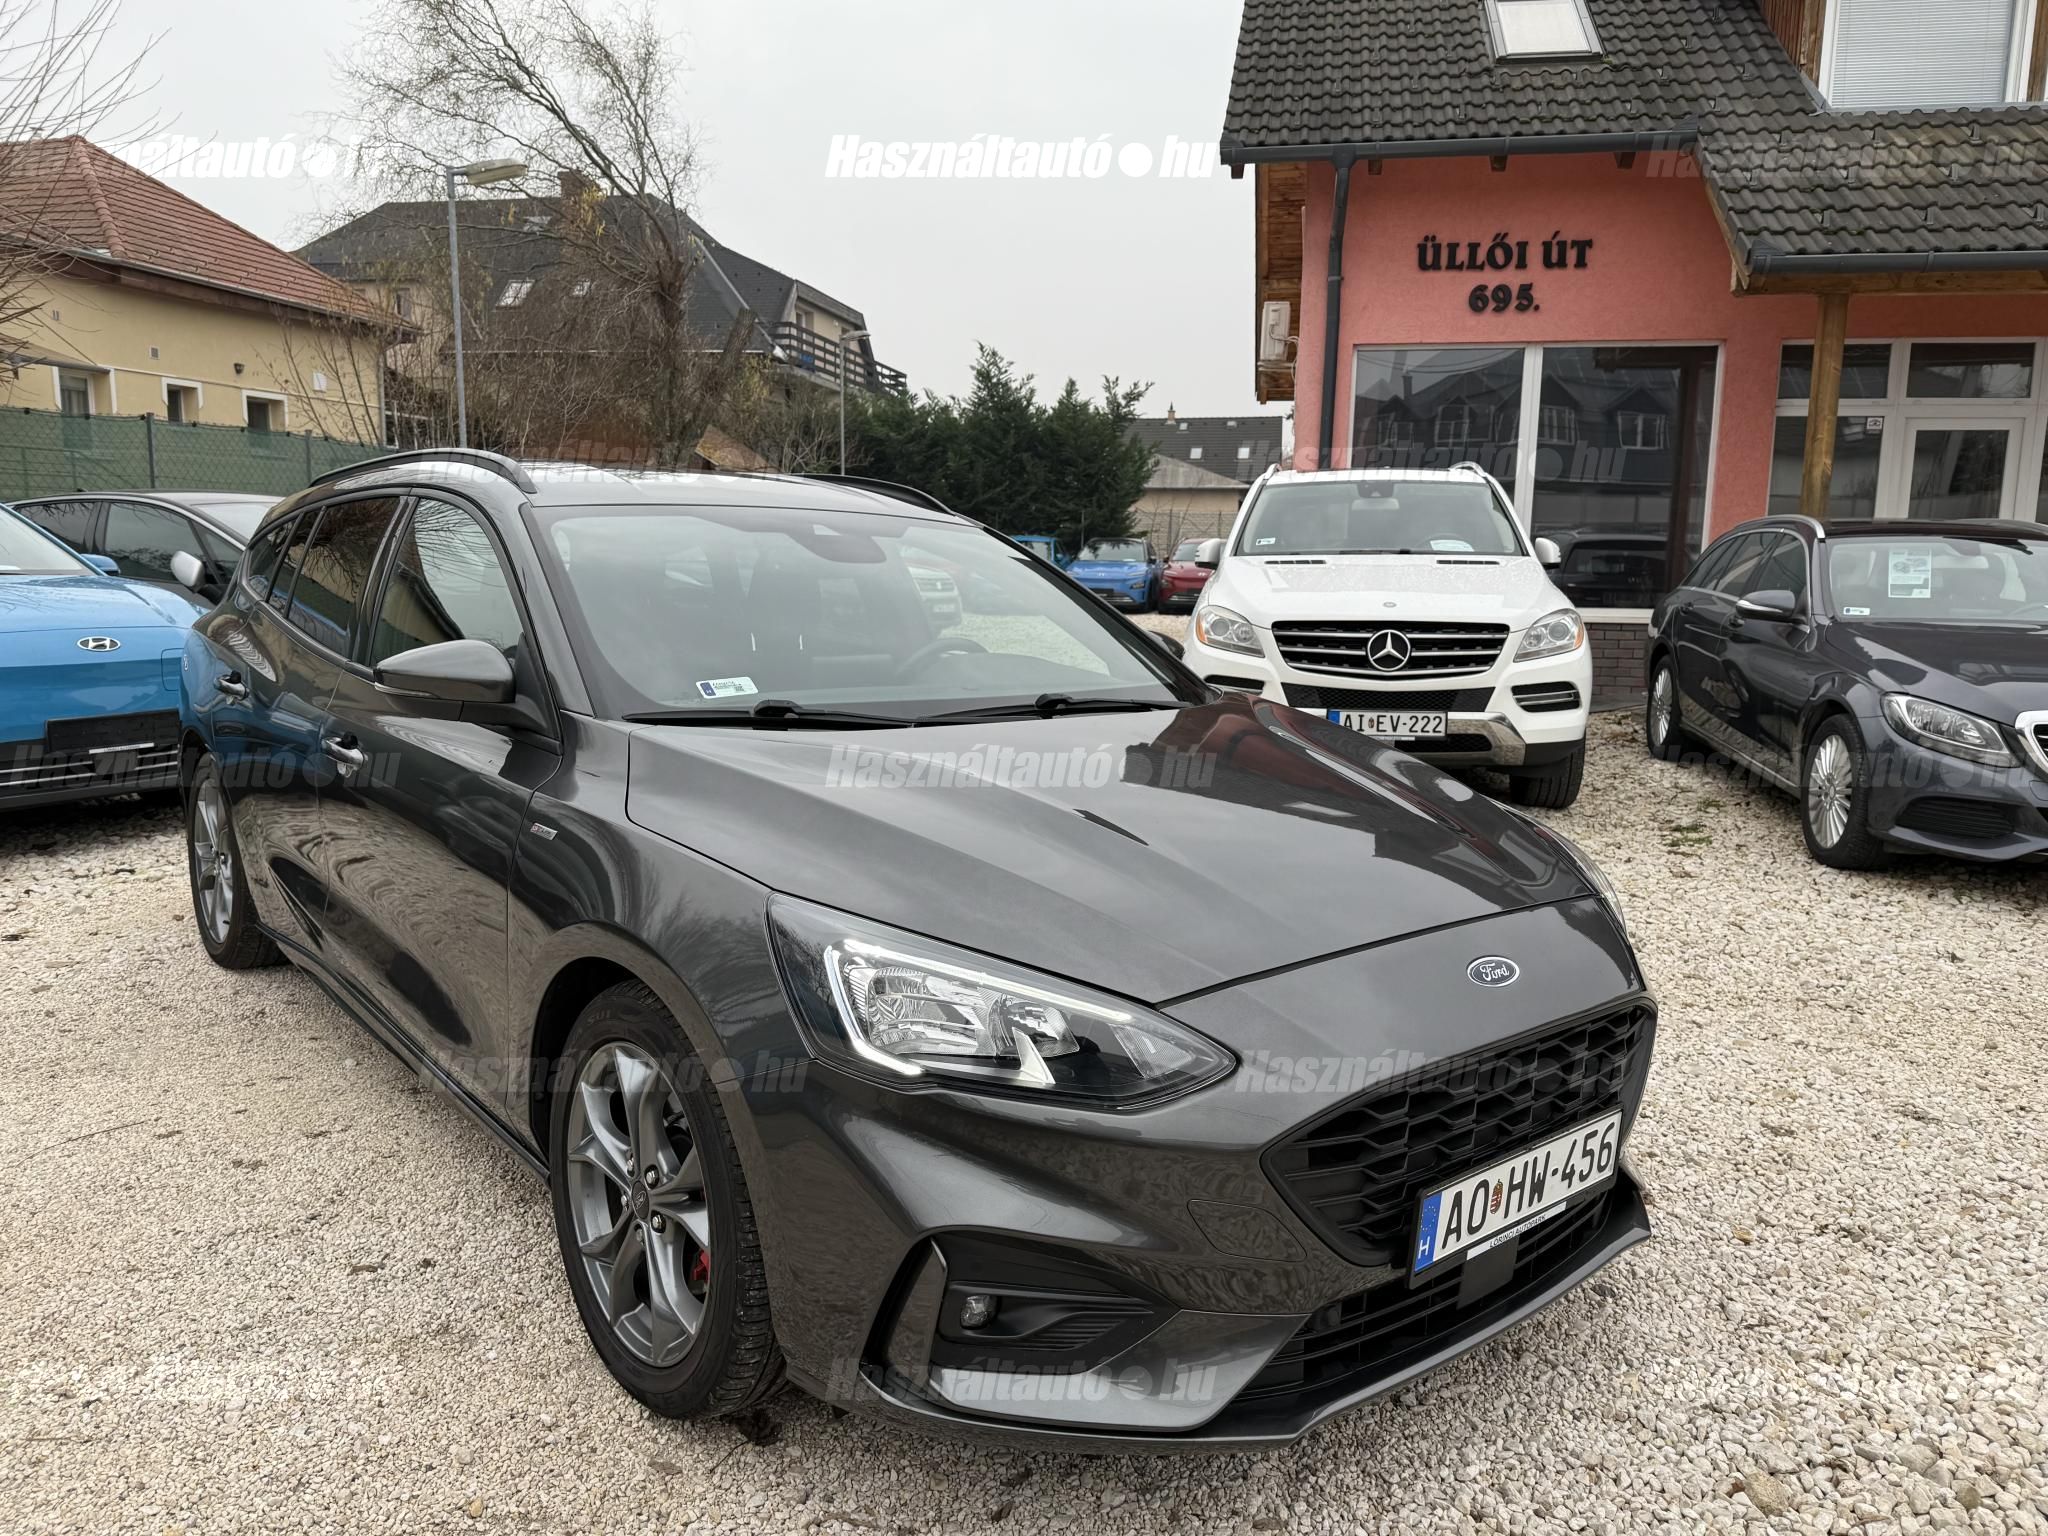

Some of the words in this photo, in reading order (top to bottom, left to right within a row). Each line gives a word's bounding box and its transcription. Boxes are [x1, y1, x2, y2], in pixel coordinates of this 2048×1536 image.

[1417, 232, 1529, 271] ÜLLŐI
[1542, 230, 1593, 270] ÚT
[1468, 283, 1540, 313] 695.
[1376, 715, 1443, 734] EV-222
[1479, 962, 1510, 981] Ford
[1441, 1178, 1490, 1250] AO
[1503, 1121, 1616, 1219] HW-456
[1514, 1213, 1547, 1237] AUTOPARK
[1417, 1236, 1431, 1260] H
